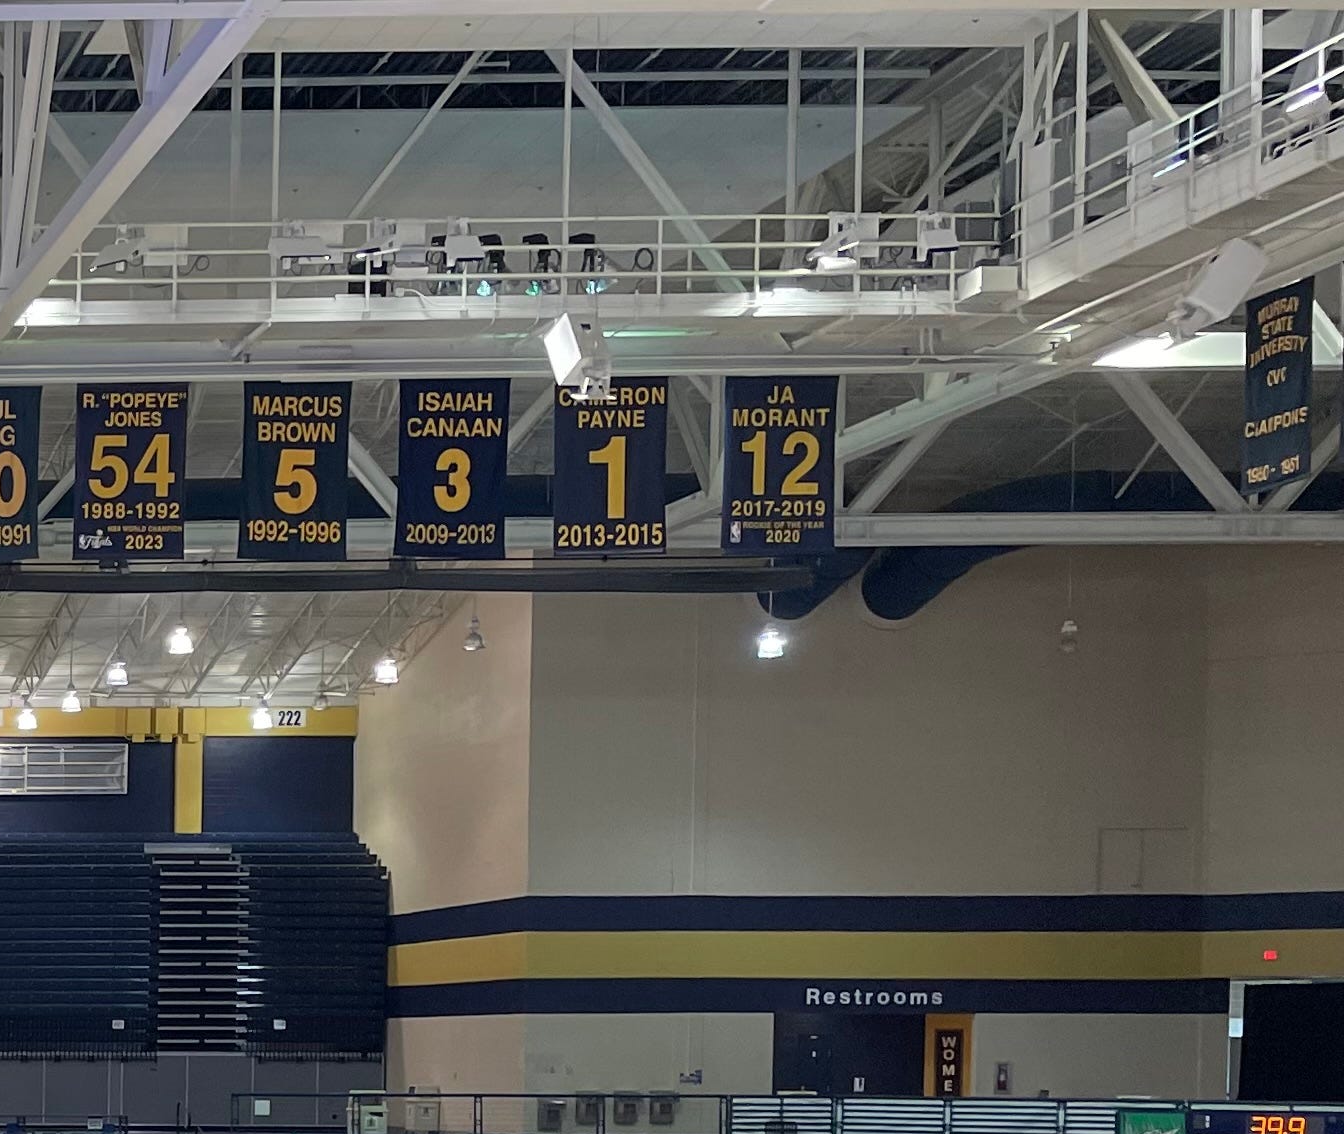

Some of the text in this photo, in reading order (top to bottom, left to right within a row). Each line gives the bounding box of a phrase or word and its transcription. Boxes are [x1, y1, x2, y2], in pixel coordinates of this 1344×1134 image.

[1262, 316, 1294, 339] STATE
[83, 392, 187, 409] R. "POPEYE"
[418, 392, 493, 412] ISAIAH
[768, 385, 794, 404] JA
[252, 396, 342, 417] MARCUS
[105, 412, 162, 428] JONES
[407, 418, 502, 437] CANAAN
[577, 410, 645, 428] PAYNE
[732, 408, 830, 427] MORANT
[257, 422, 336, 443] BROWN
[88, 433, 175, 499] 54
[741, 431, 820, 496] 12
[273, 448, 318, 515] 5
[433, 448, 472, 512] 3
[589, 436, 626, 519] 1
[81, 502, 180, 519] 1988-1992
[732, 500, 825, 516] 2017-2019
[247, 520, 341, 543] 1992-1996
[406, 524, 496, 544] 2009-2013
[557, 523, 663, 547] 2013-2015
[766, 530, 800, 543] 2020
[125, 535, 163, 549] 2023
[278, 710, 302, 728] 222
[805, 987, 944, 1007] Restrooms
